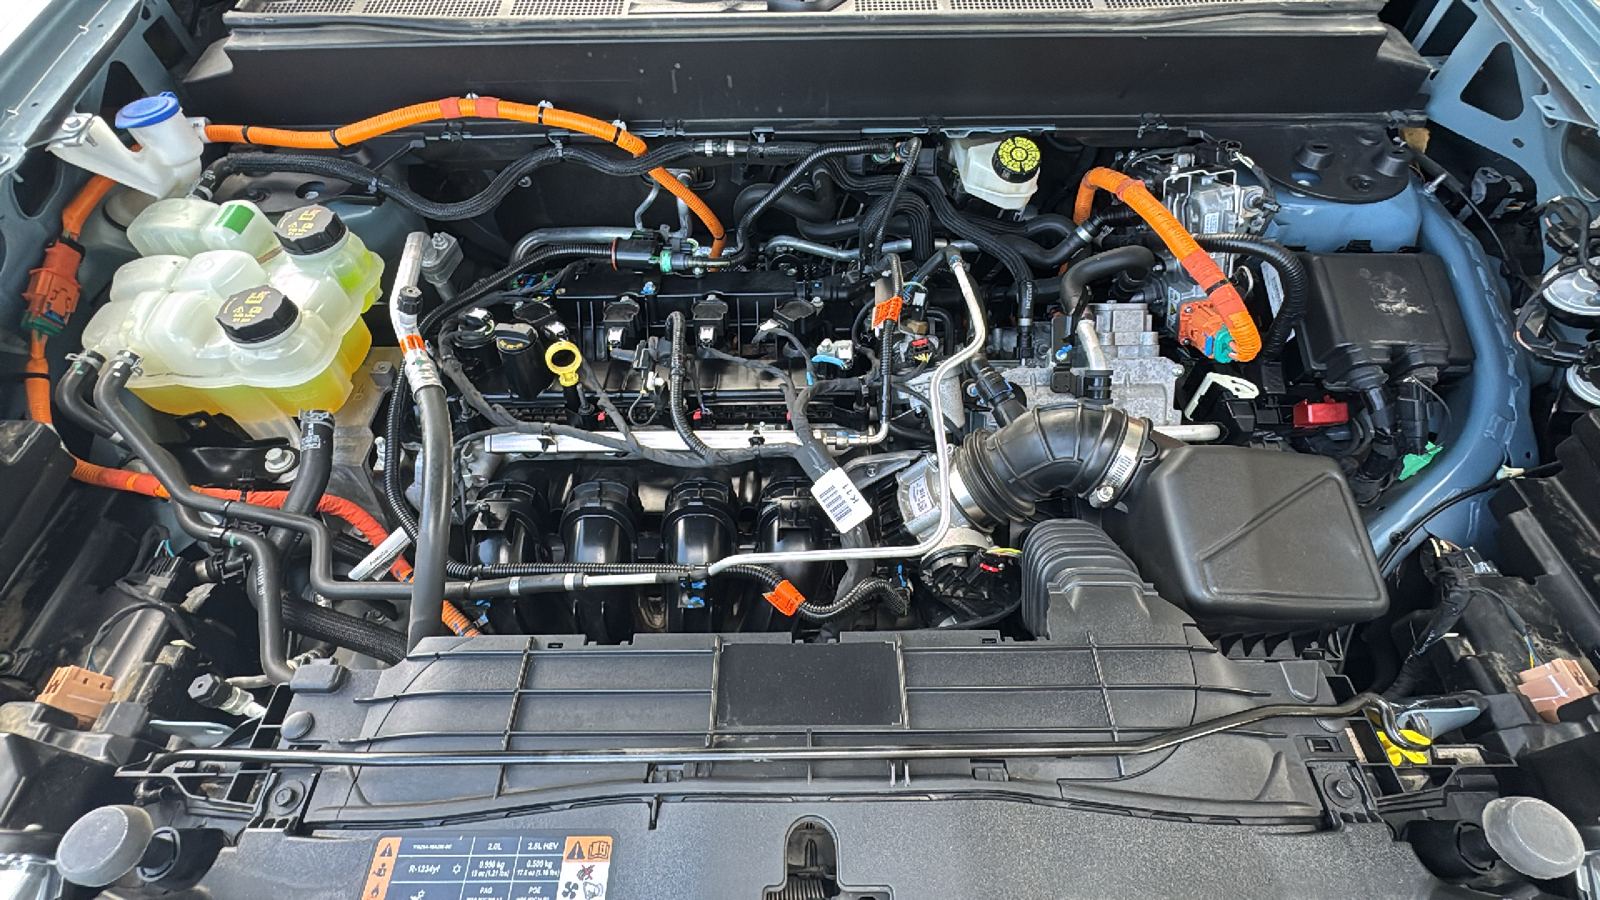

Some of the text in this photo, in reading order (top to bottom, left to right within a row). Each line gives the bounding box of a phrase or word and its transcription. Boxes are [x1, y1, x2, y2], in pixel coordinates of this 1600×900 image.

[487, 842, 502, 851] 2.0L
[543, 842, 559, 850] HEV
[408, 864, 441, 875] R-1234yf
[544, 859, 554, 870] kg
